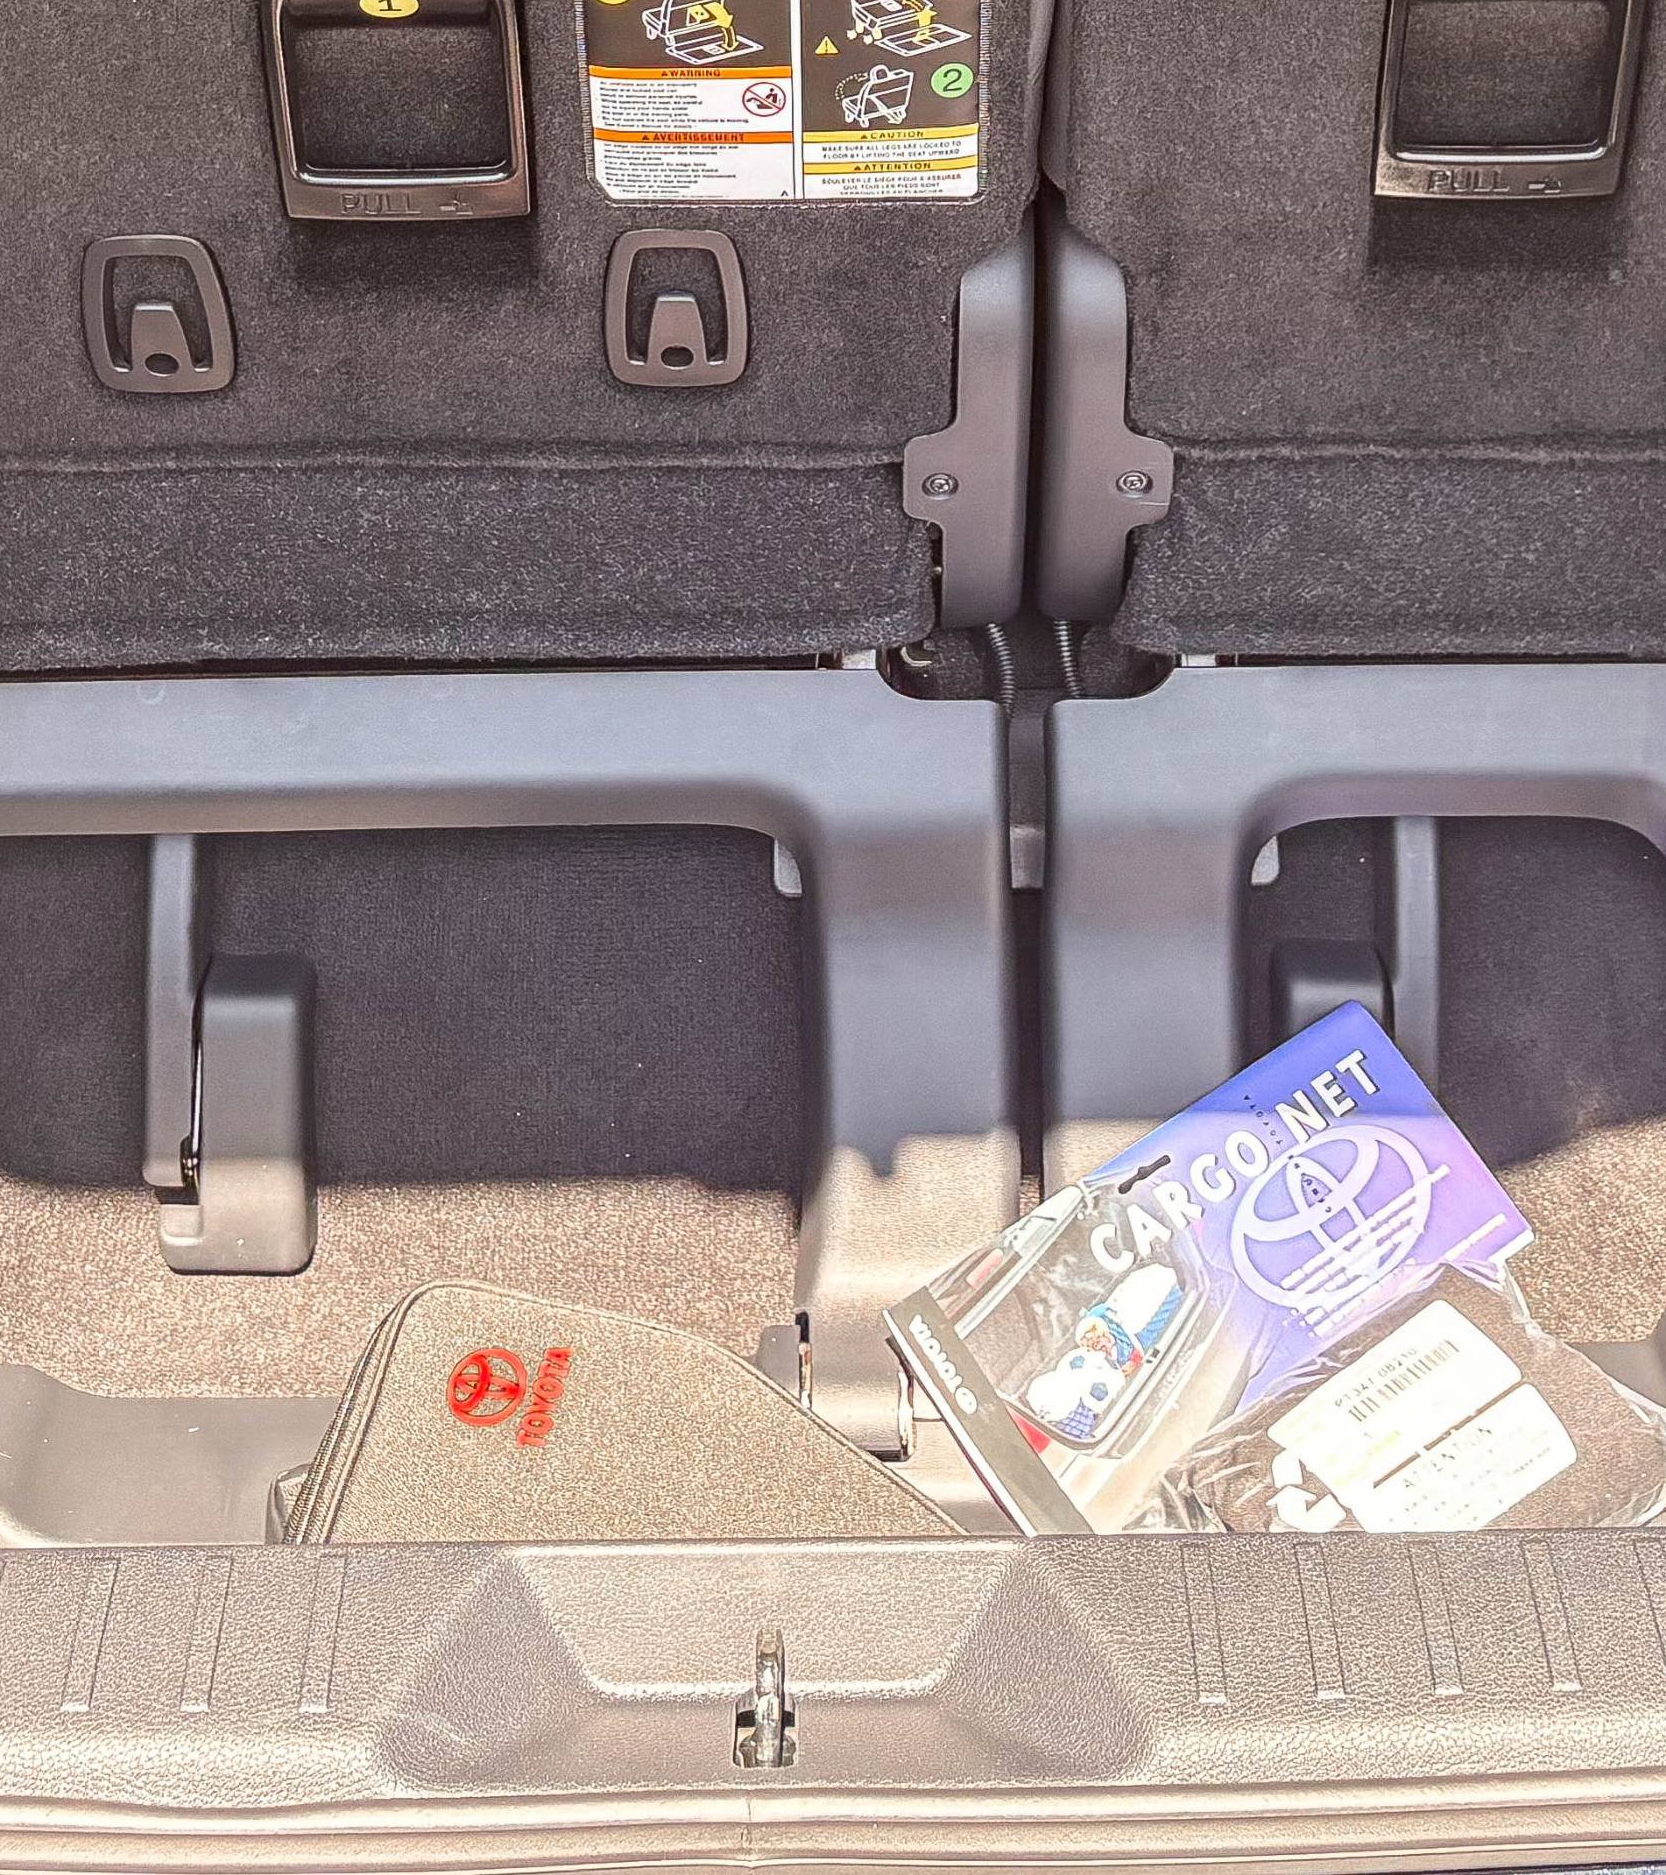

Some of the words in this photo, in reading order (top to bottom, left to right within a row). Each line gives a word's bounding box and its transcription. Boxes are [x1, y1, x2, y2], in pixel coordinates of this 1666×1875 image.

[942, 68, 964, 93] 2
[870, 131, 924, 139] CAUTION
[864, 162, 931, 171] ATTENTION
[1426, 170, 1511, 193] PULL
[340, 192, 422, 215] PULL
[1089, 1130, 1269, 1274] CARGO
[1274, 1049, 1381, 1144] NET
[516, 1347, 574, 1448] TOYOTA
